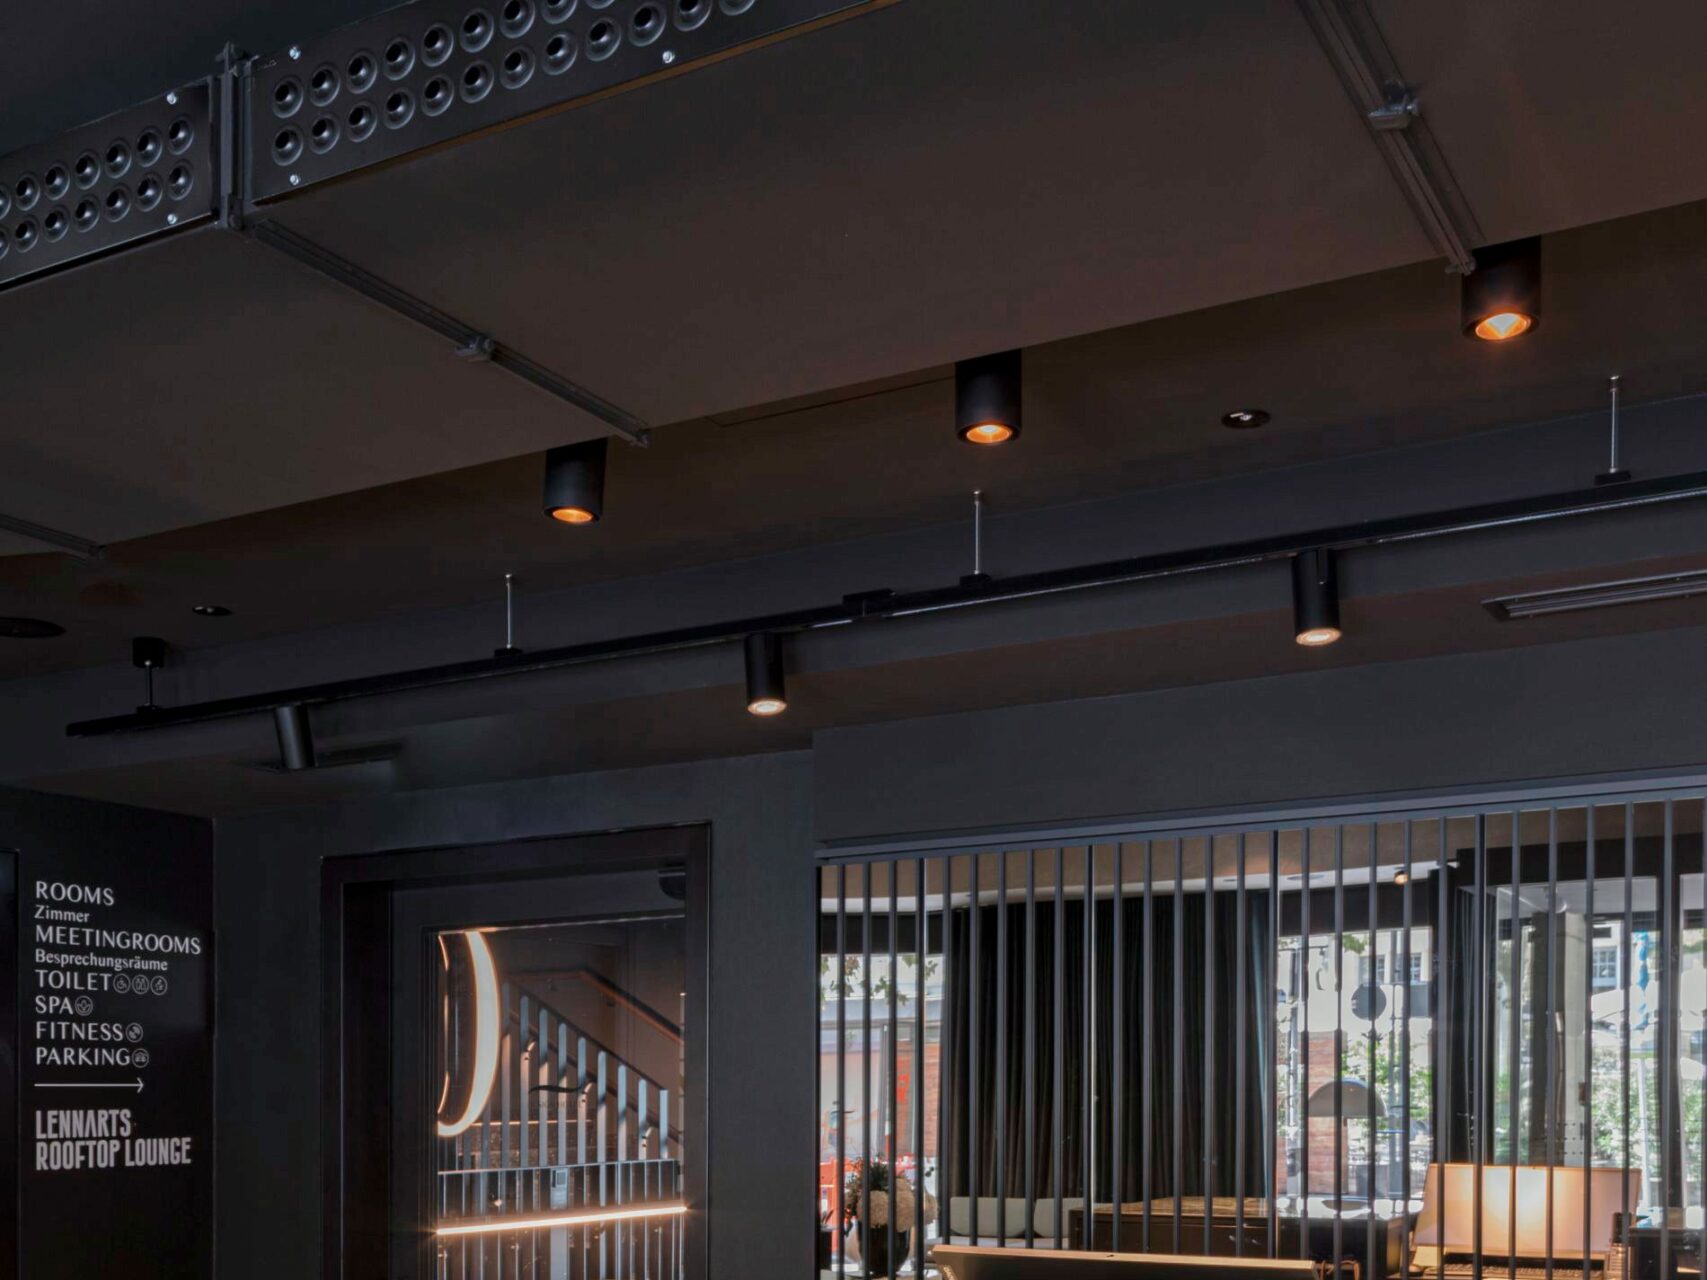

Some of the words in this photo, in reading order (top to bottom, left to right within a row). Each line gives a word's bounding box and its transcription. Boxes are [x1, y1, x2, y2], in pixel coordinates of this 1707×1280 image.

[35, 880, 115, 906] ROOMS
[34, 904, 90, 923] Zimmer
[35, 924, 201, 955] MEETINGROOMS
[35, 949, 168, 972] Besprechungsräume
[35, 969, 112, 991] TOILET
[35, 994, 74, 1015] SPA
[36, 1020, 124, 1042] FITNESS
[36, 1046, 131, 1066] PARKING
[35, 1108, 132, 1139] LENNARTS
[36, 1139, 121, 1171] ROOFTOP
[124, 1137, 192, 1167] LOUNGE
